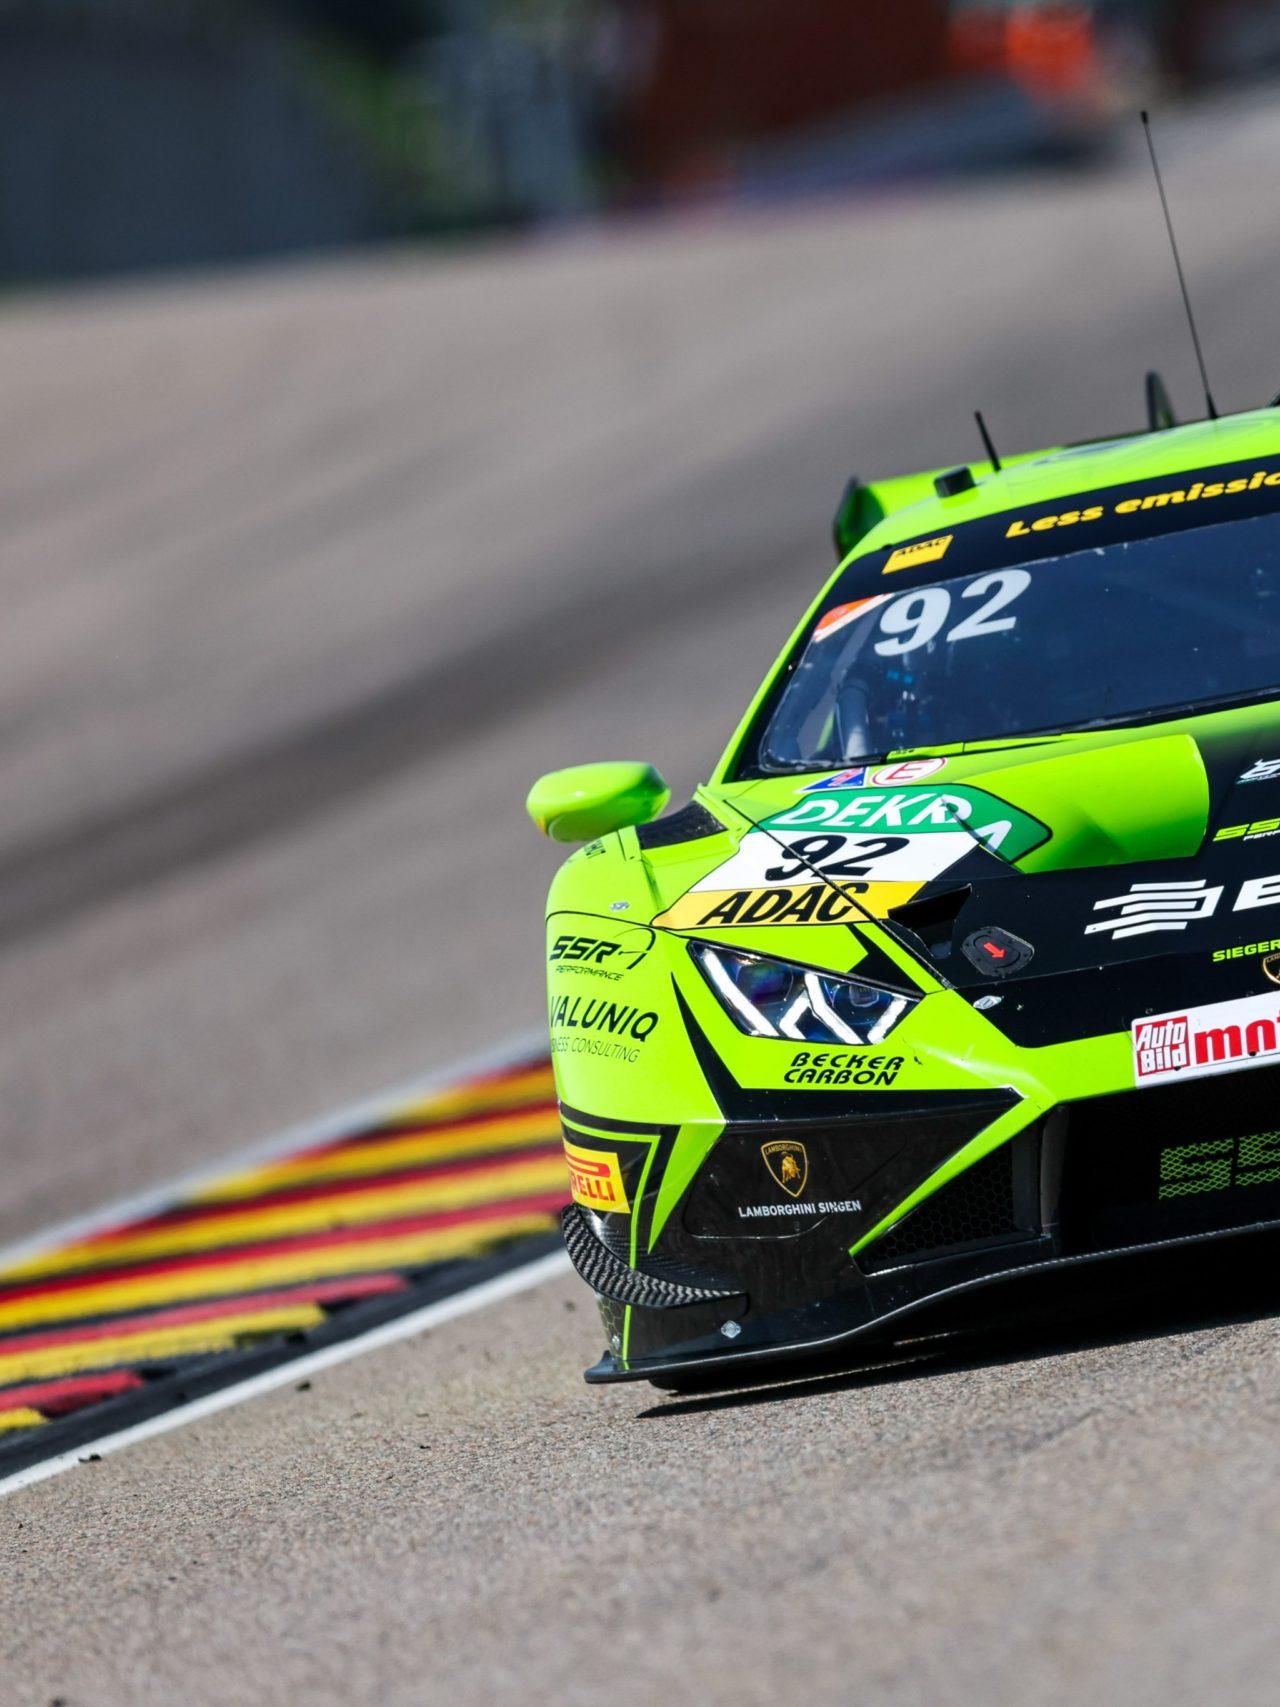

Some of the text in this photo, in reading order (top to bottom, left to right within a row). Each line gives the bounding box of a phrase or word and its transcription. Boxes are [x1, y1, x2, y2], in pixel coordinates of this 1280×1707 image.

[1005, 502, 1104, 537] Less
[873, 568, 1032, 656] 92
[770, 793, 1013, 854] DEKRA
[765, 834, 910, 882] 92
[696, 882, 870, 926] ADAC
[549, 935, 622, 964] SSR
[550, 995, 659, 1042] VALUNIQ
[571, 1037, 641, 1063] CONSULTING
[1137, 1021, 1187, 1051] Auto
[790, 1051, 905, 1071] BECKER
[1140, 1041, 1188, 1074] Bild
[783, 1068, 898, 1086] CARBON
[765, 1144, 803, 1155] LAMBORGHINI
[738, 1200, 863, 1218] LAMBORGHINI SINGEN
